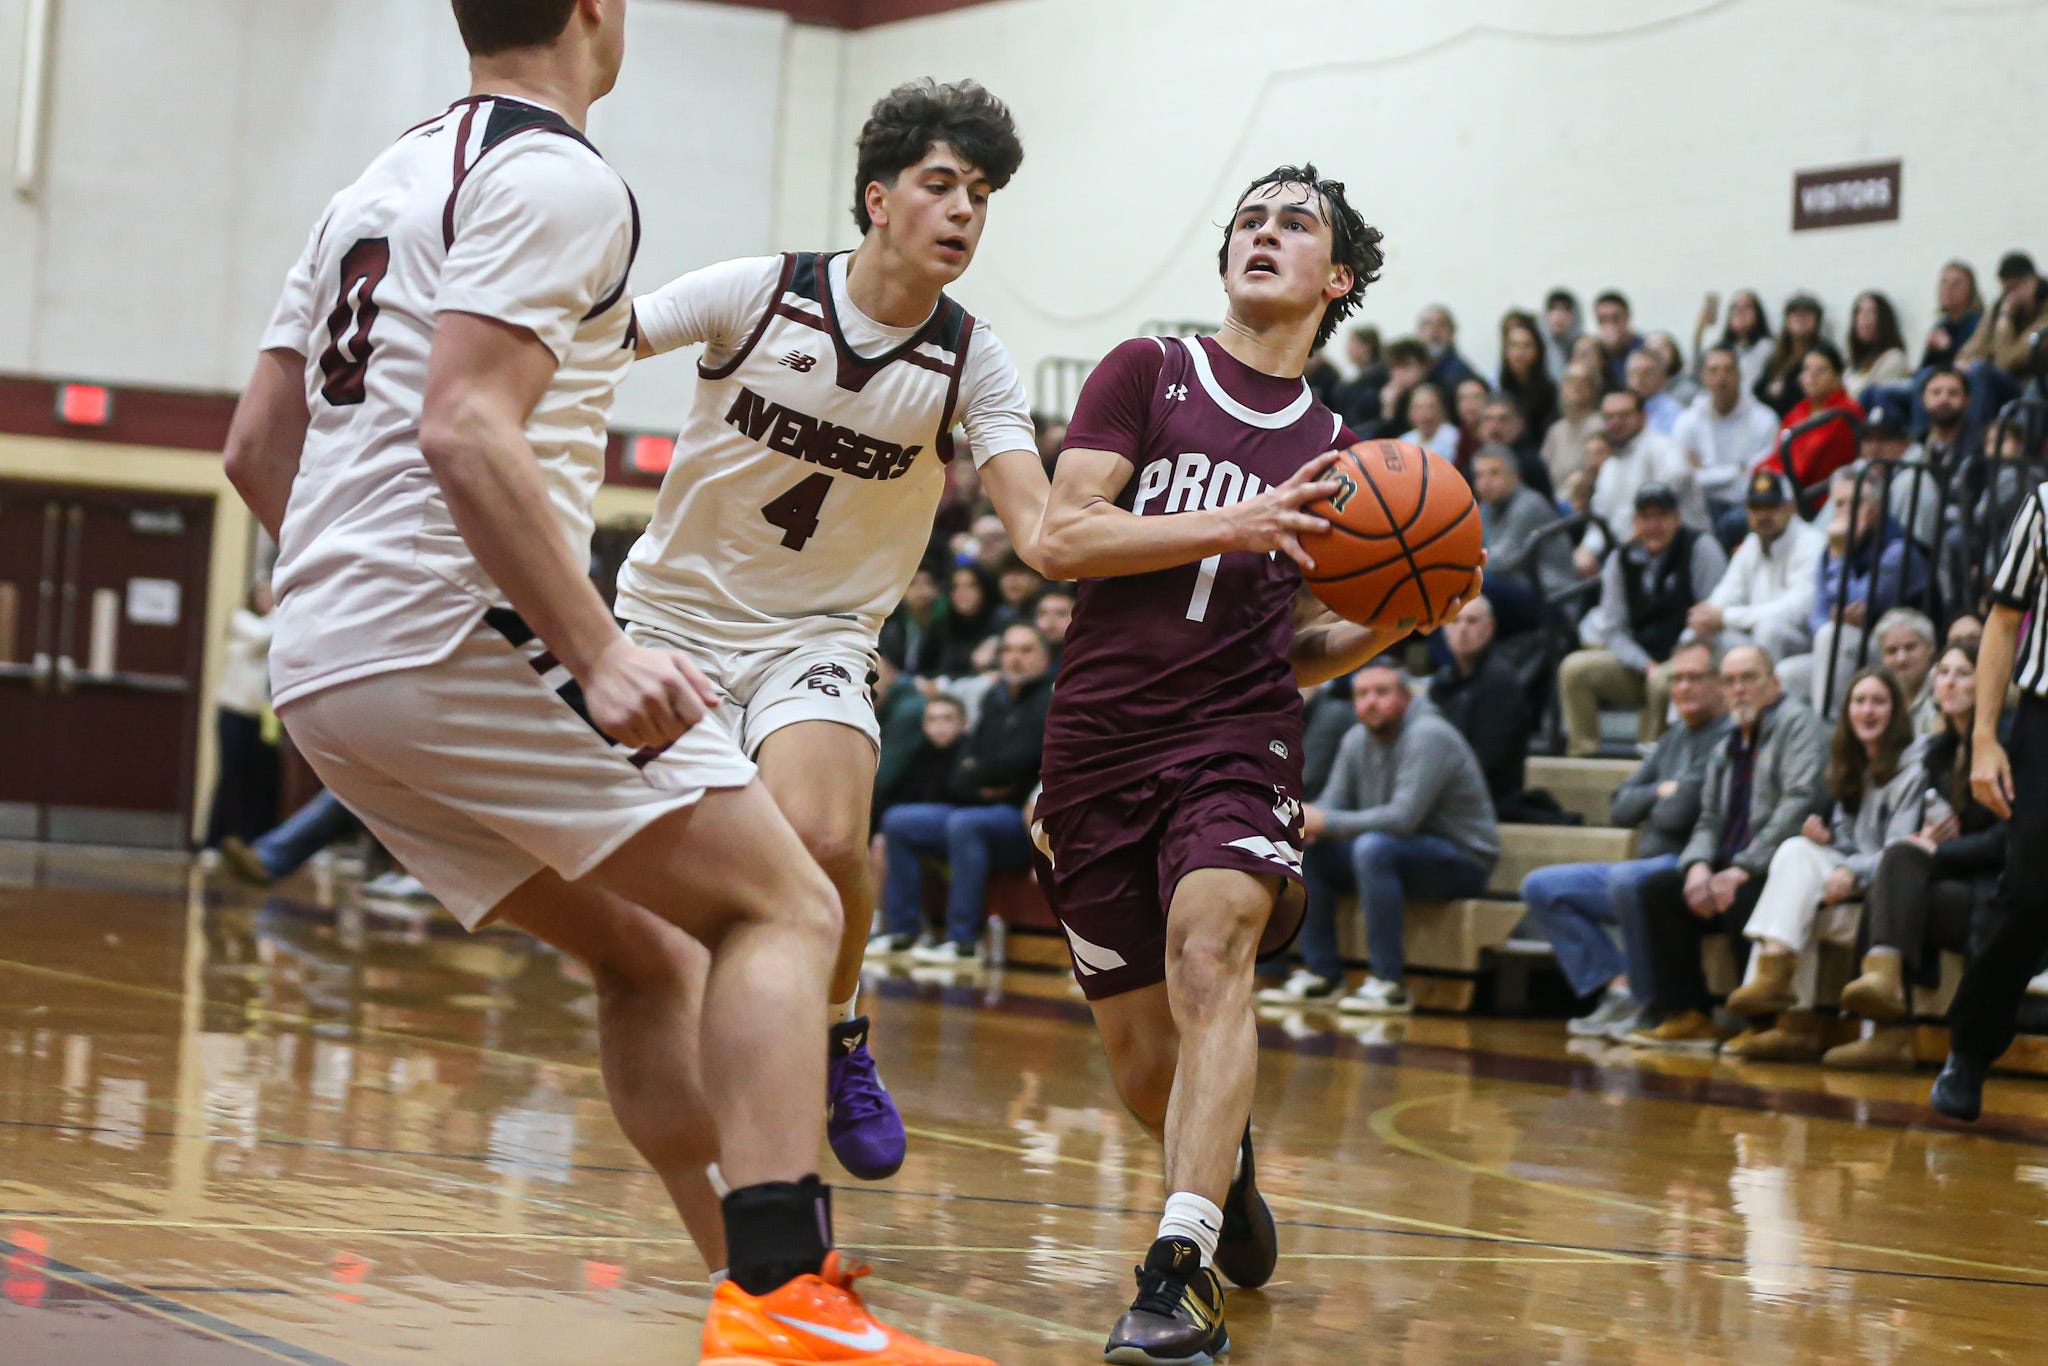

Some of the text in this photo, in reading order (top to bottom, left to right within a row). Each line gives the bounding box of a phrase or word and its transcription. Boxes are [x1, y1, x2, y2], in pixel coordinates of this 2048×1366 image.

[319, 236, 391, 407] 0
[724, 386, 924, 481] AVENGERS
[761, 471, 835, 552] 4
[807, 677, 841, 697] EG
